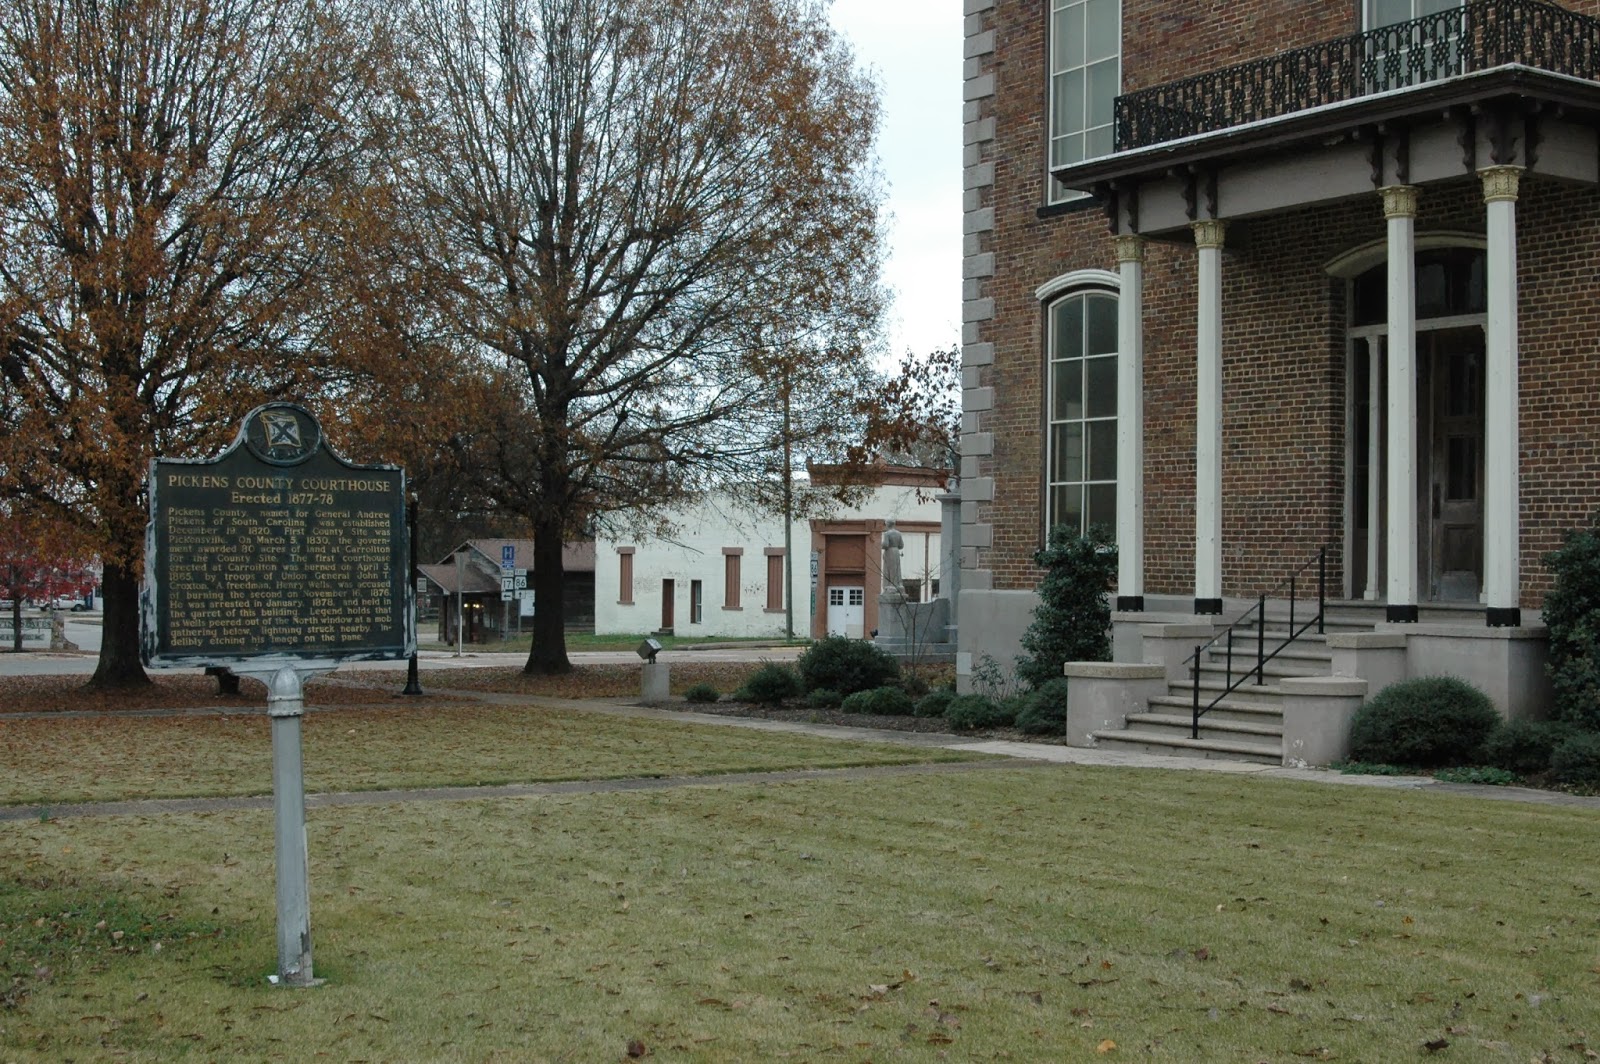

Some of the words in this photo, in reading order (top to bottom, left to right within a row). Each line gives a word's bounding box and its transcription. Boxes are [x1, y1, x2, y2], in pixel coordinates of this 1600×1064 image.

[168, 475, 228, 488] PICKENS
[237, 477, 293, 488] COUNTY
[302, 479, 390, 491] COURTHOUSE
[232, 492, 281, 504] Erected
[288, 494, 333, 505] 1877-78
[169, 507, 205, 516] Pickens
[313, 527, 343, 536] County
[504, 547, 512, 558] H
[218, 555, 250, 564] County
[357, 563, 378, 572] April
[205, 573, 216, 582] by
[187, 591, 224, 600] burning
[210, 600, 250, 608] arrested
[191, 610, 220, 619] garret
[310, 608, 342, 616] Legend
[209, 618, 241, 628] peered
[171, 628, 217, 638] gathering
[262, 627, 302, 636] lightning
[171, 637, 203, 646] delibly
[210, 637, 245, 645] etching
